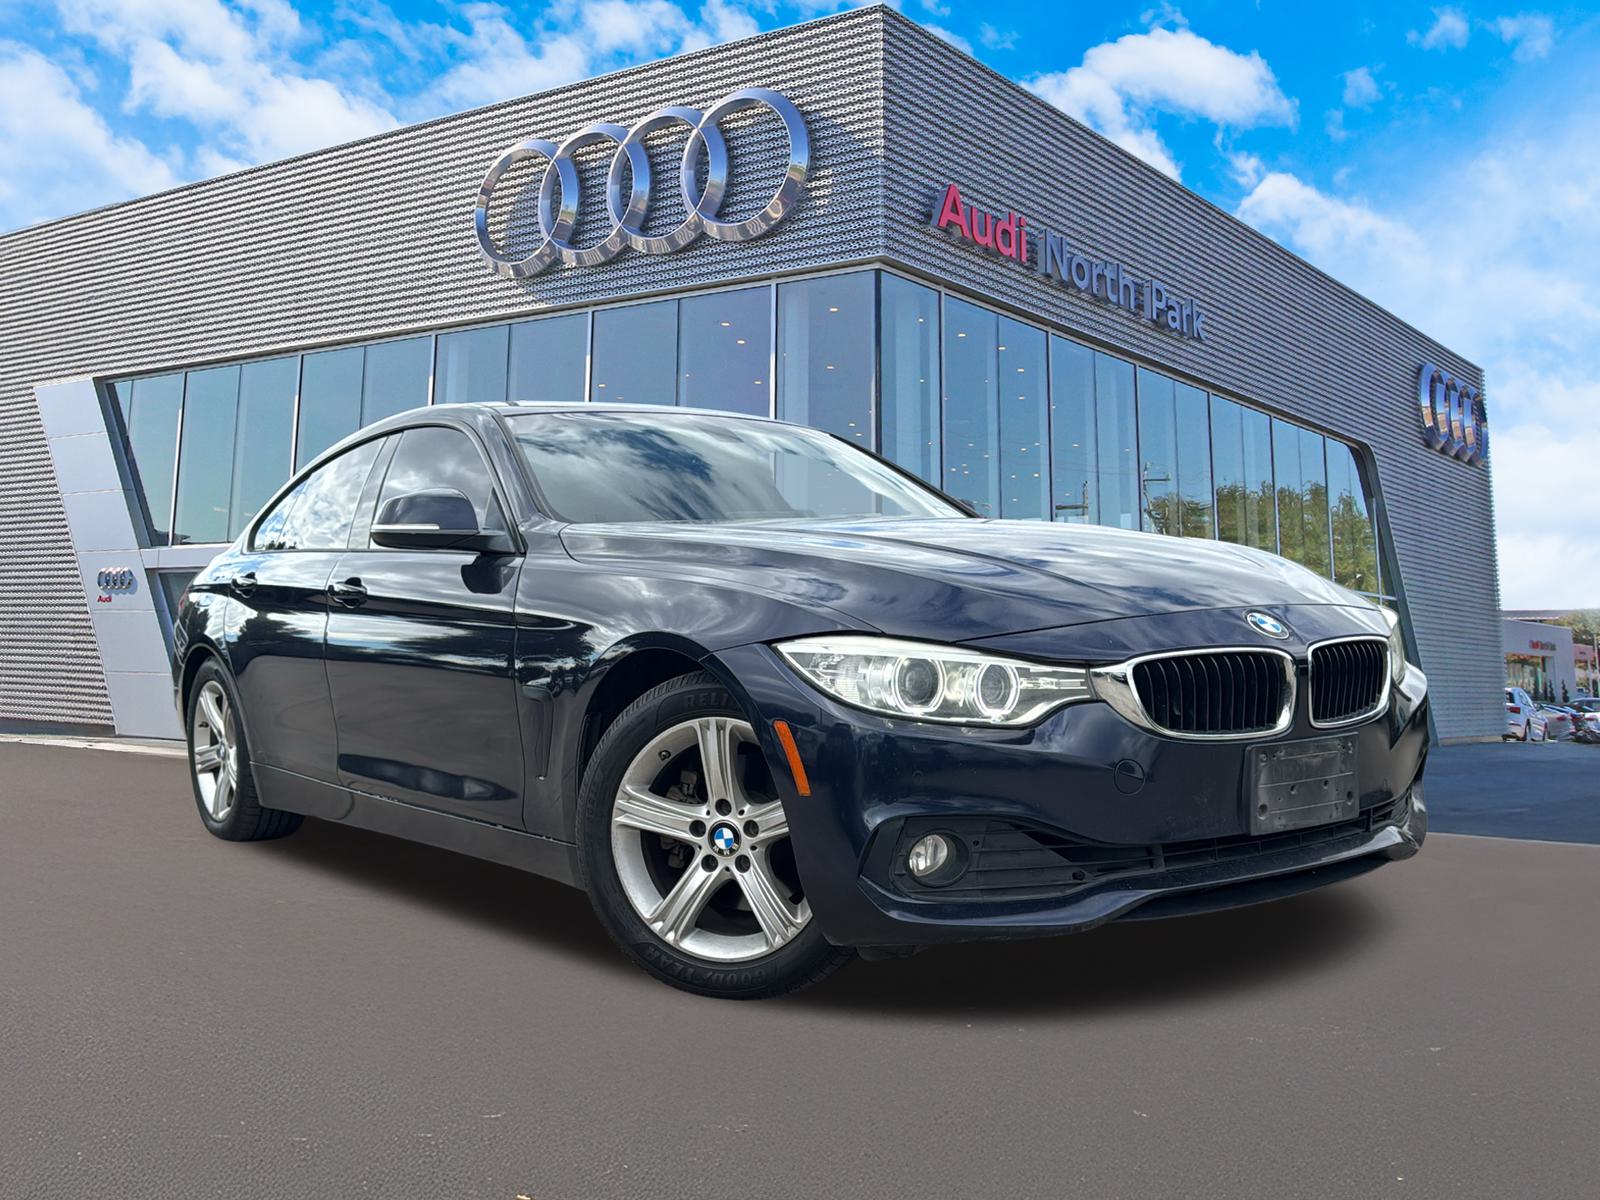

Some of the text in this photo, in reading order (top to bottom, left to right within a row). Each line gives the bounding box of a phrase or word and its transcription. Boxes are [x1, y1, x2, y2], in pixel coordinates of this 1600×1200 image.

[933, 183, 1207, 341] Audi North Park
